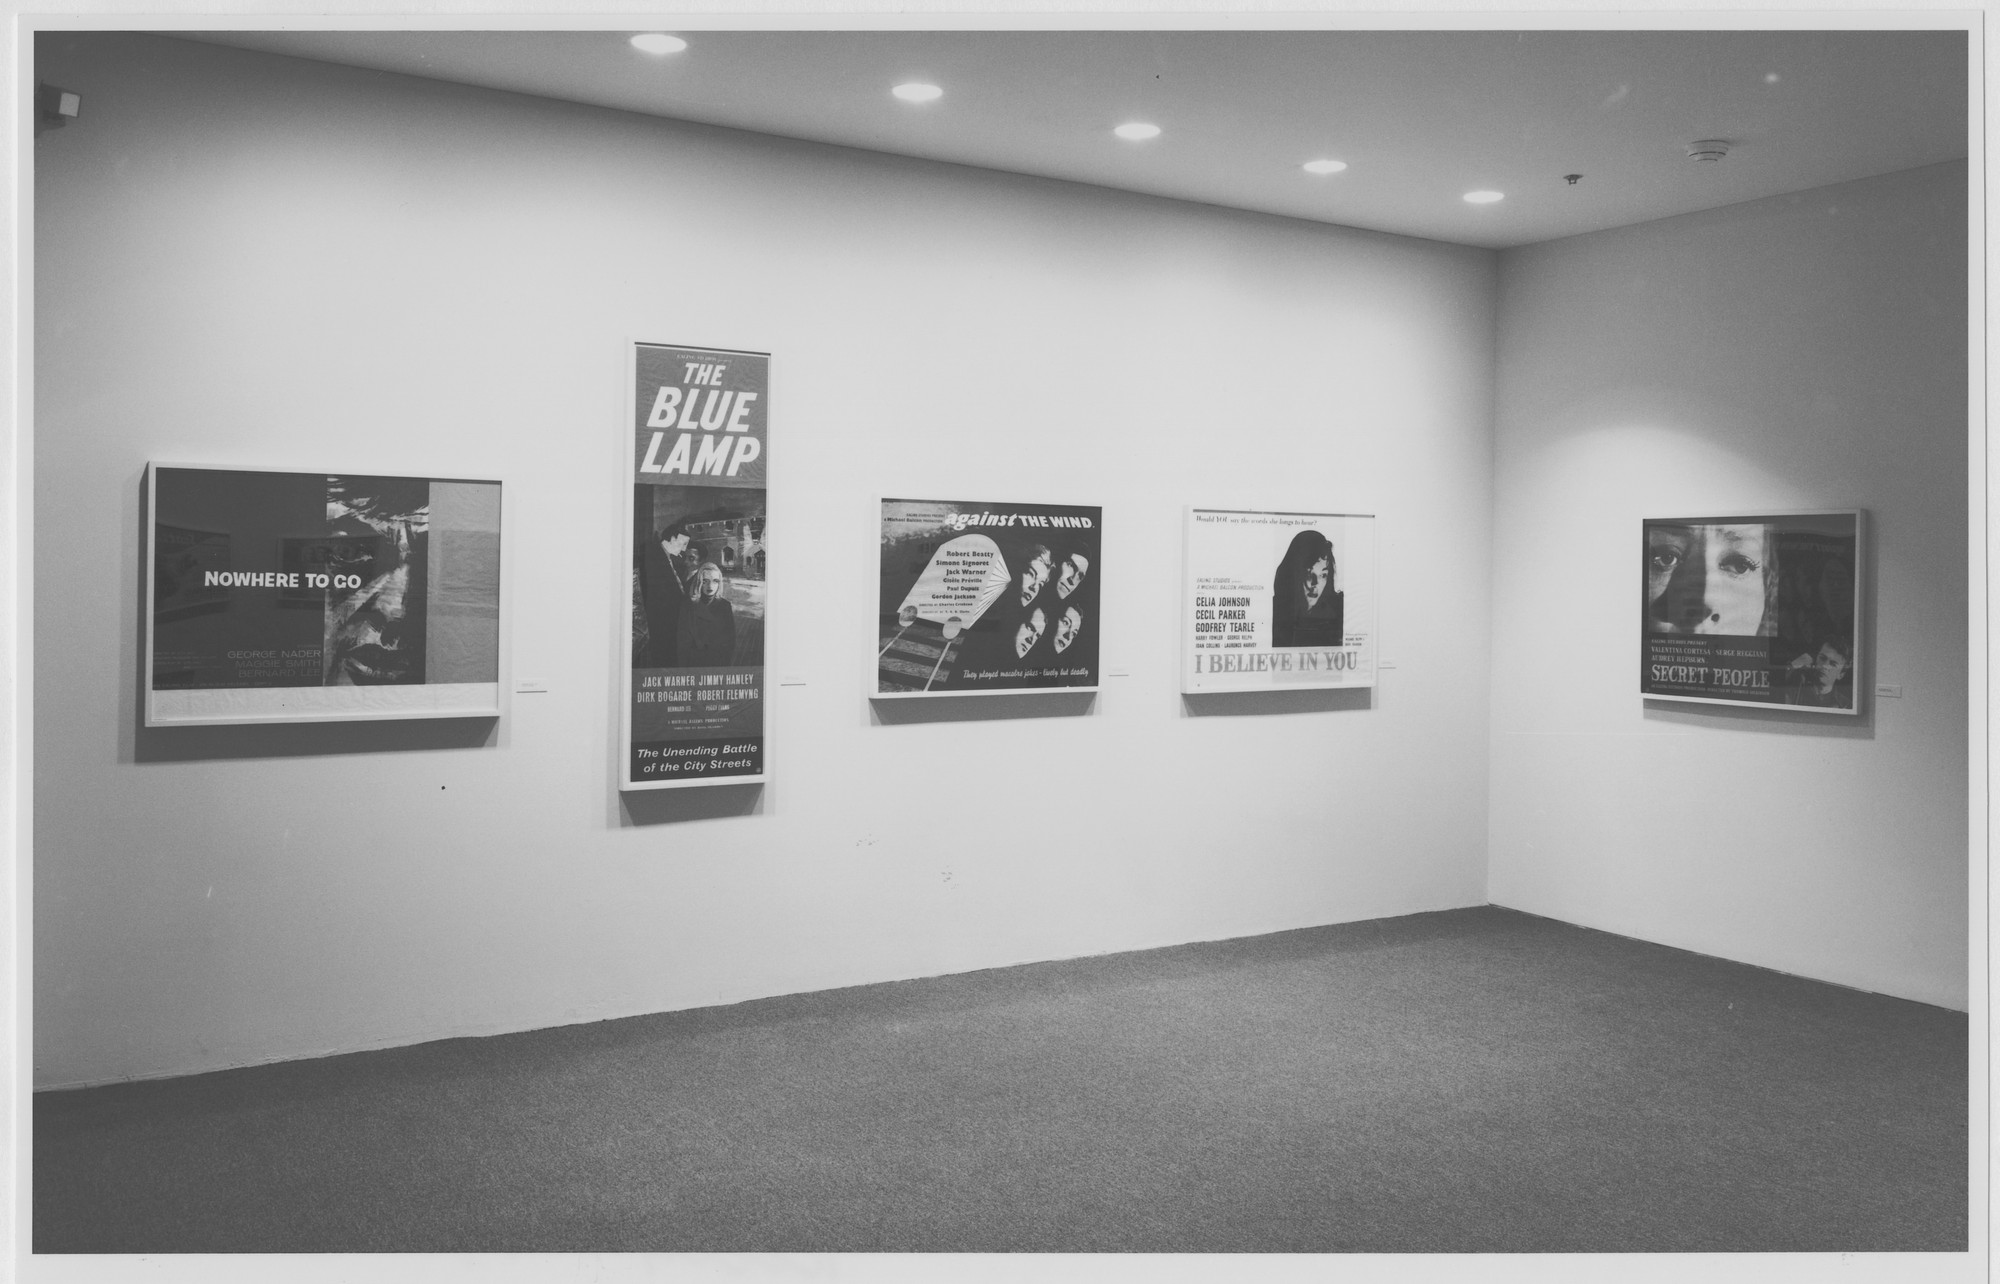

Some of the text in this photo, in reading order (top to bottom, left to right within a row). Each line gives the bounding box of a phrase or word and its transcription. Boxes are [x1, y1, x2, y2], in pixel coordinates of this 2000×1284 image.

[683, 362, 727, 386] THE
[646, 385, 758, 433] BLUE
[639, 431, 761, 477] LAMP
[945, 511, 1092, 531] against THE WIND
[972, 551, 994, 559] Beatty
[204, 570, 362, 589] NOWHERE TO GO
[1195, 597, 1251, 607] CELIA JOHNSON
[1195, 609, 1246, 620] CECIL PARKER
[1195, 622, 1255, 633] GODFREY TEARLE
[227, 650, 277, 659] GEORGE
[281, 649, 321, 658] NADER
[1651, 646, 1683, 654] VALENTINA
[1683, 648, 1711, 656] CORTESA
[1715, 649, 1736, 657] SERGE
[1651, 654, 1706, 664] AUDREY HEPBURN
[235, 659, 321, 668] MAGGIE SMITH
[1194, 651, 1358, 673] I BELIEVE IN YOU
[239, 668, 321, 678] BERNARD LEE
[642, 673, 754, 688] JACK WARNER JIMMY HANLEY
[963, 670, 977, 680] They
[979, 670, 999, 680] played
[1023, 669, 1038, 679] jokes
[1043, 668, 1058, 678] lively
[1060, 668, 1069, 676] but
[1070, 667, 1088, 677] deadly
[1651, 664, 1770, 688] SECRET PEOPLE
[637, 688, 759, 703] DIRK BOGARDE ROBERT FLEMYNG
[637, 744, 758, 759] The Unending Battle
[643, 758, 752, 773] of the City Streets
